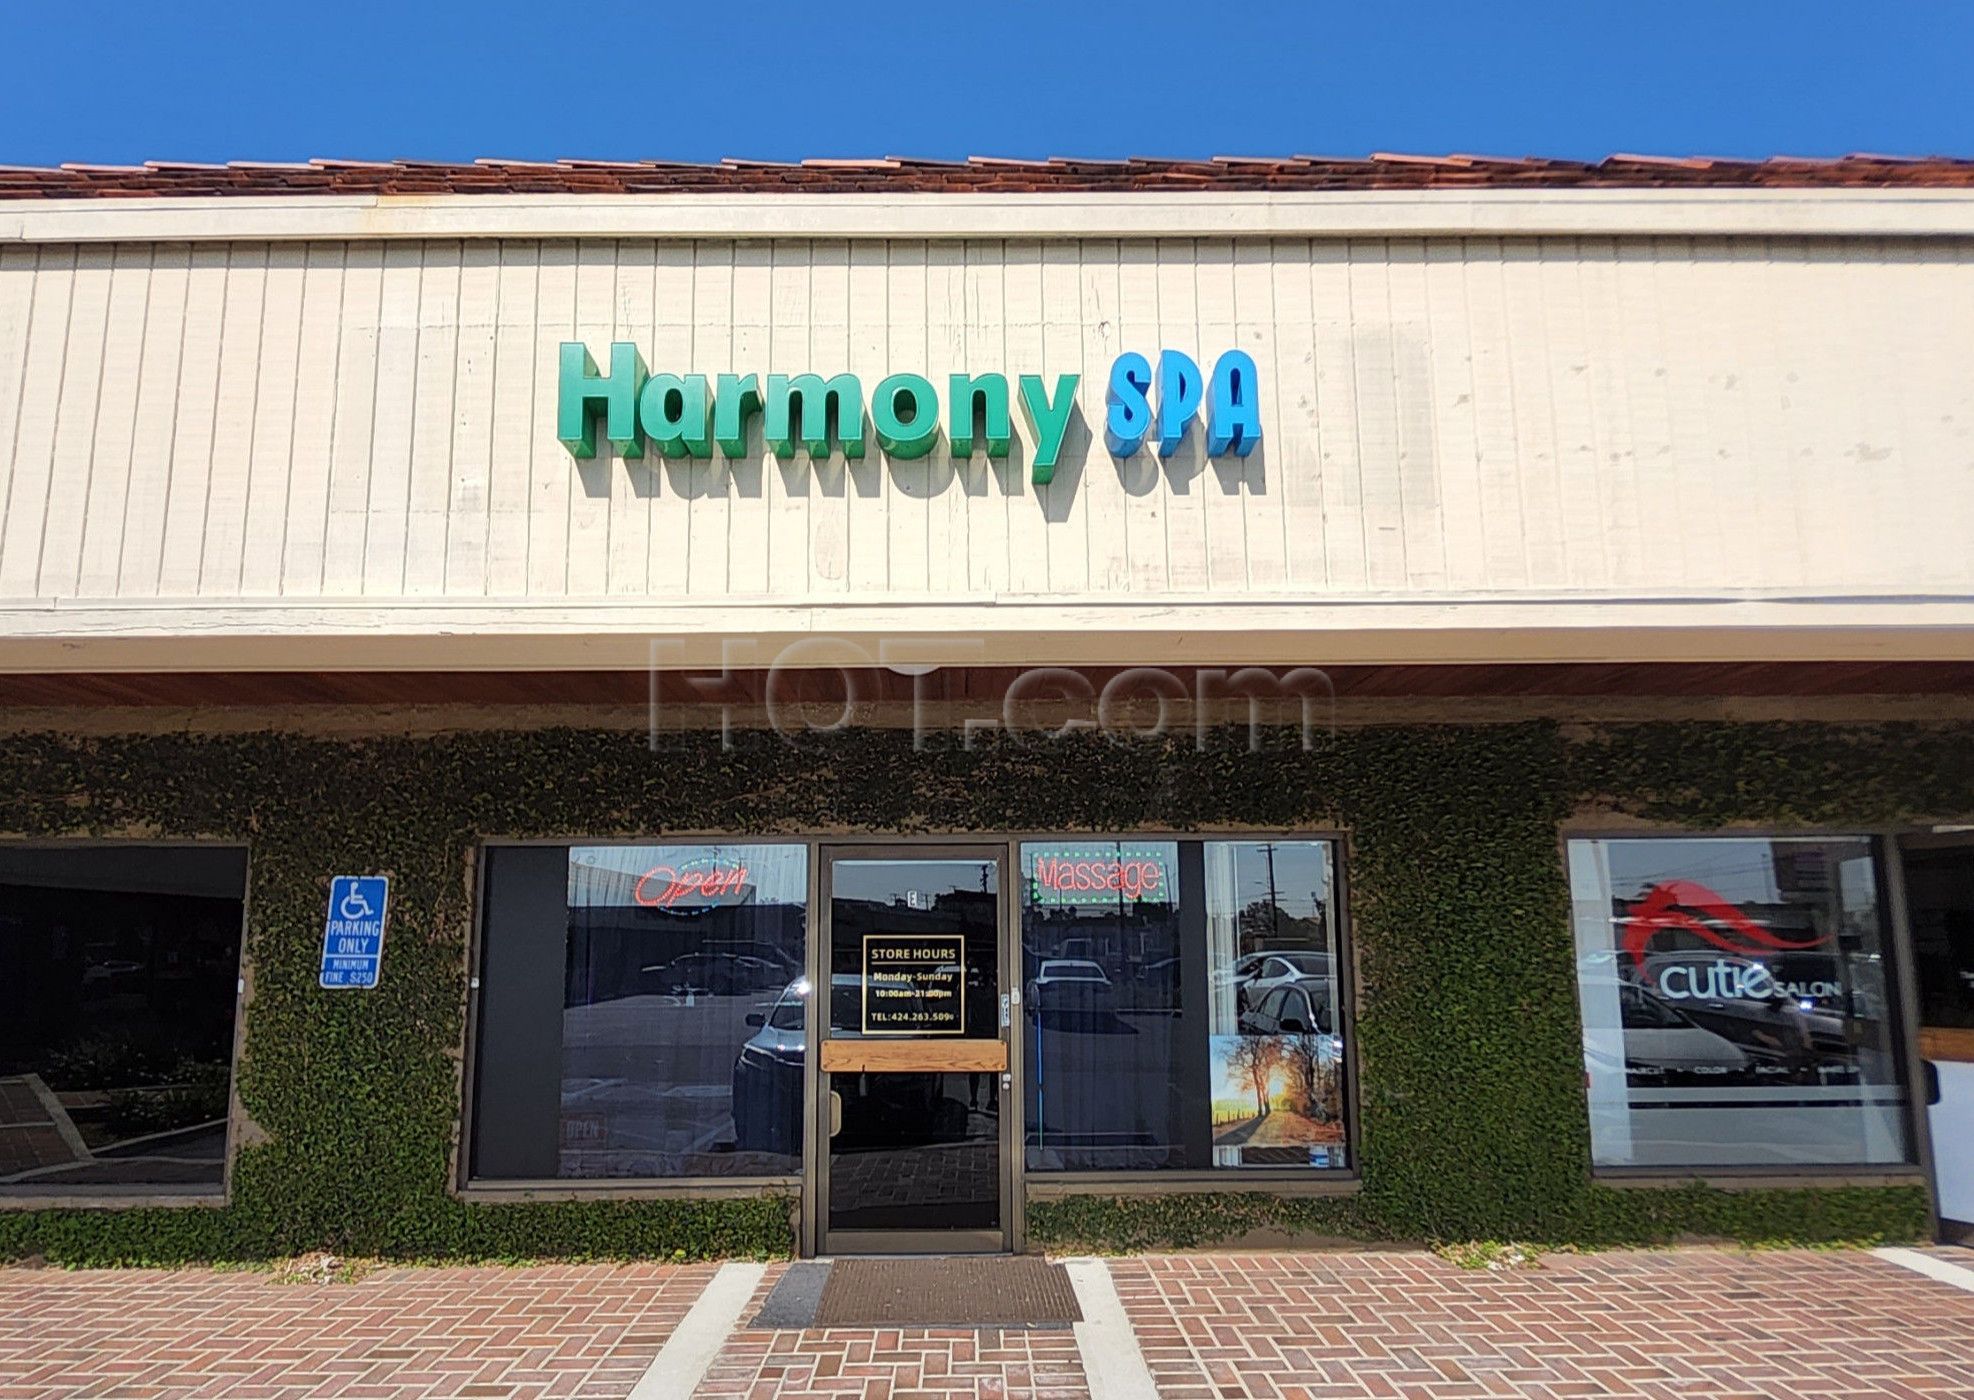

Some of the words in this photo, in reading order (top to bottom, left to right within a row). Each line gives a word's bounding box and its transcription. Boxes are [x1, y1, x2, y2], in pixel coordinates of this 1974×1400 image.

[558, 342, 1081, 486] Harmony
[1104, 350, 1262, 458] SPA
[1037, 856, 1160, 899] Massage
[635, 865, 748, 907] Open
[330, 920, 380, 936] PARKING
[338, 938, 369, 953] ONLY
[871, 949, 910, 959] STORE
[913, 949, 956, 959] HOURS
[333, 959, 369, 970] MINIMUM
[325, 971, 343, 983] FINE
[349, 972, 374, 983] $250
[873, 972, 953, 982] Monday-Sunday
[1660, 959, 1774, 999] cutie
[1773, 981, 1842, 998] SALON
[566, 1119, 599, 1138] OPEN
